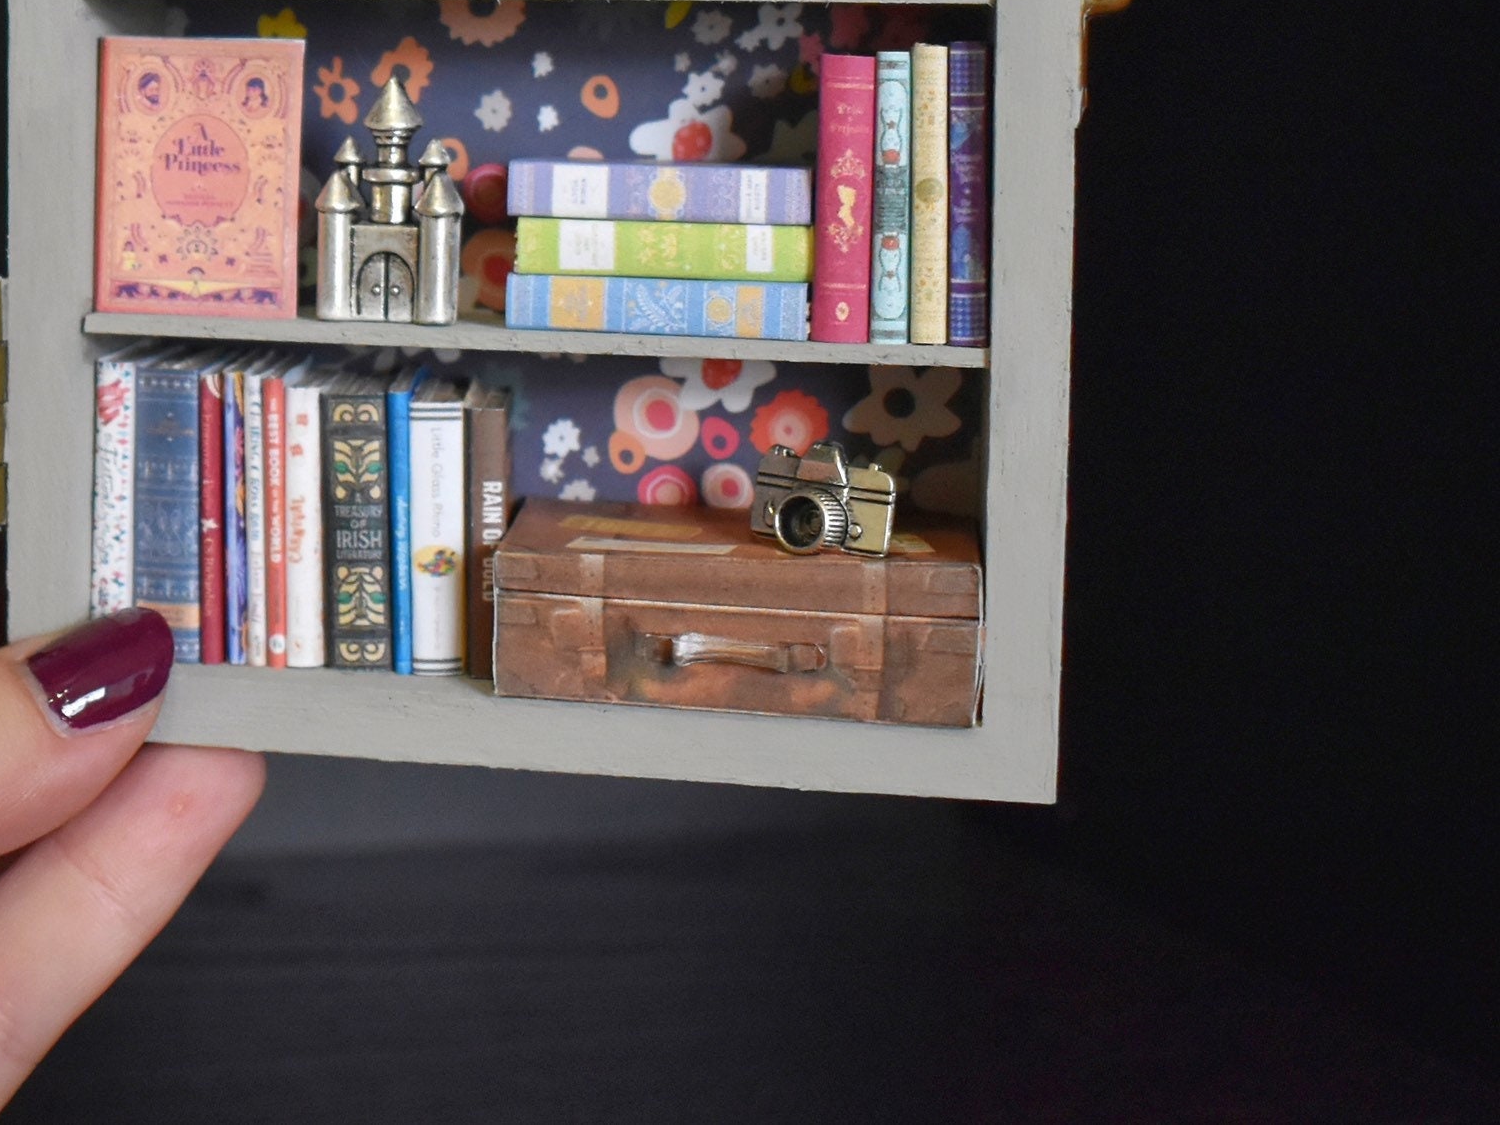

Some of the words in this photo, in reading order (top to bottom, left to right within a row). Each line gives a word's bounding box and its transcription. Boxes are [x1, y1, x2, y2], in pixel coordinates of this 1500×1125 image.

[159, 153, 242, 175] Princess
[267, 414, 280, 444] BEST
[431, 427, 444, 460] Little
[268, 448, 281, 487] BOOK
[431, 463, 443, 502] Glass
[334, 504, 383, 518] TREASURY
[482, 480, 504, 524] RAIN
[350, 519, 367, 528] OF
[431, 503, 443, 538] Rhino
[270, 515, 283, 564] WORLD
[336, 530, 383, 548] IRISH
